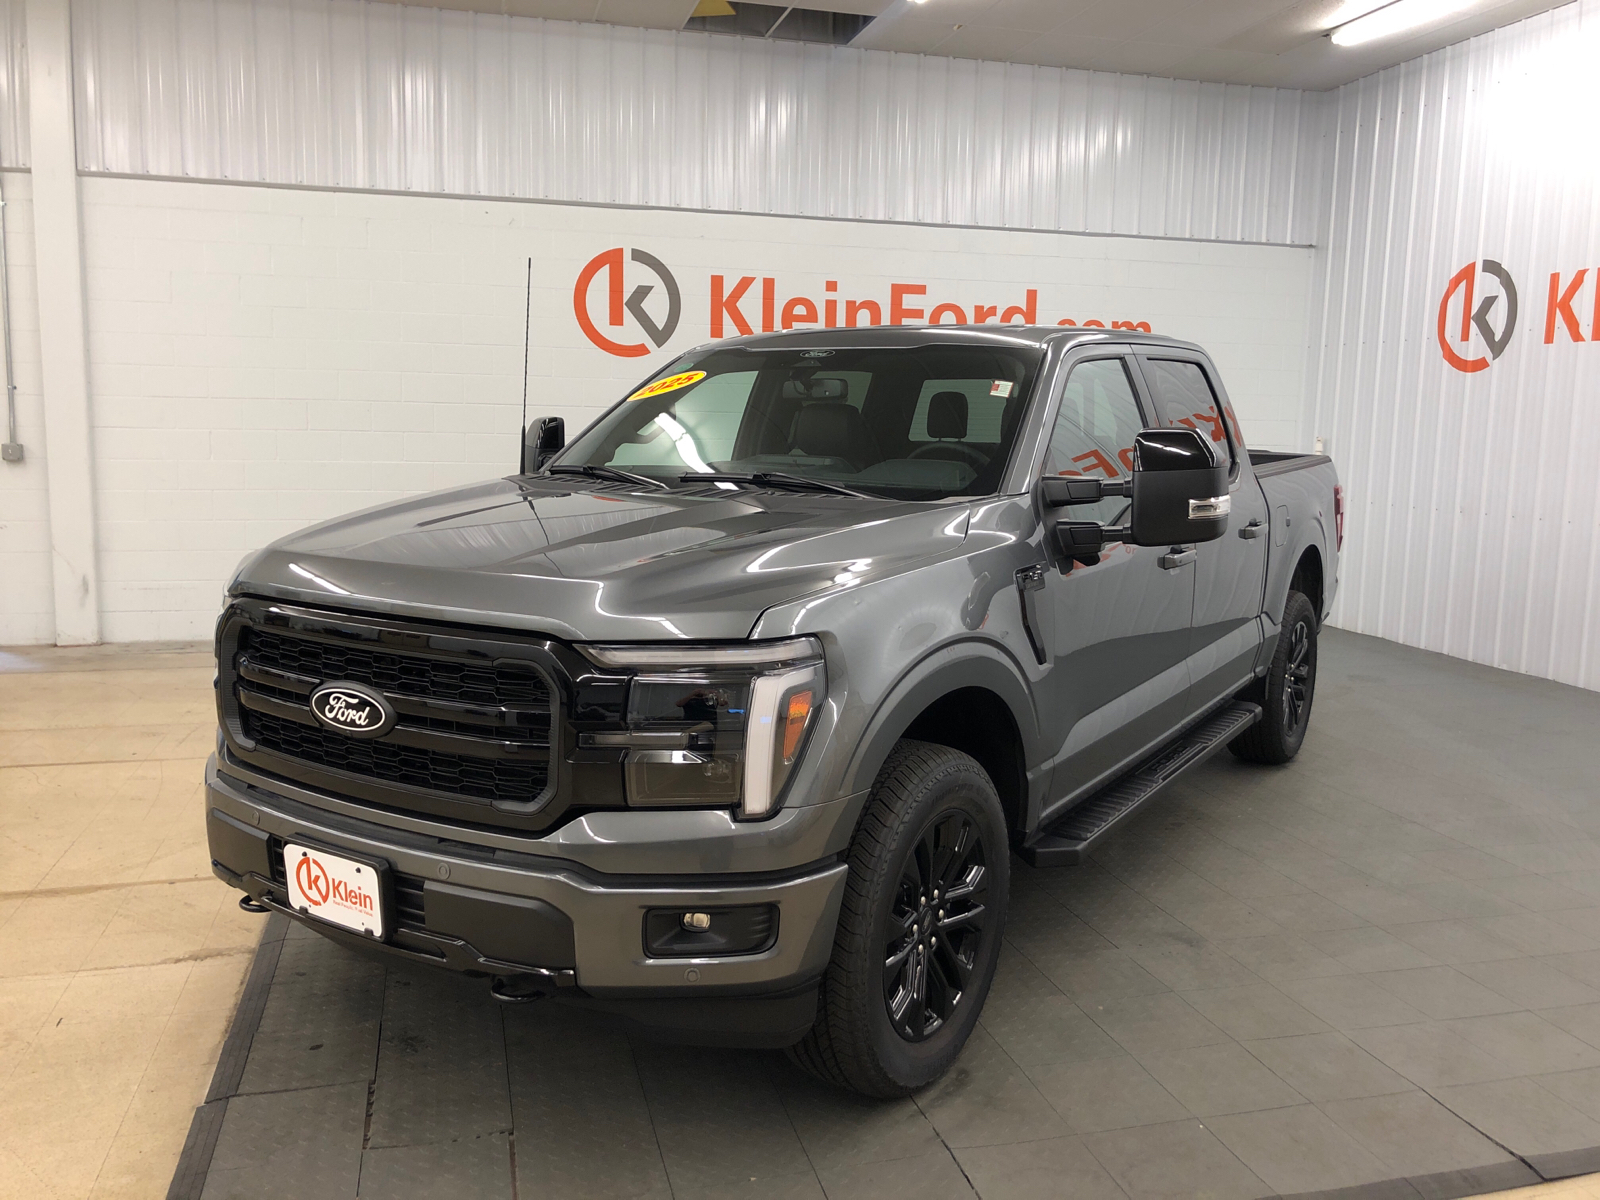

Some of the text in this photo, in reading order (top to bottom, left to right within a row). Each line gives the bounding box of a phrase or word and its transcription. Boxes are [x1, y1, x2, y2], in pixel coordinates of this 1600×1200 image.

[710, 274, 1151, 338] KleinFord
[633, 372, 699, 399] 2025
[324, 692, 371, 726] Ford
[331, 877, 374, 912] Klein
